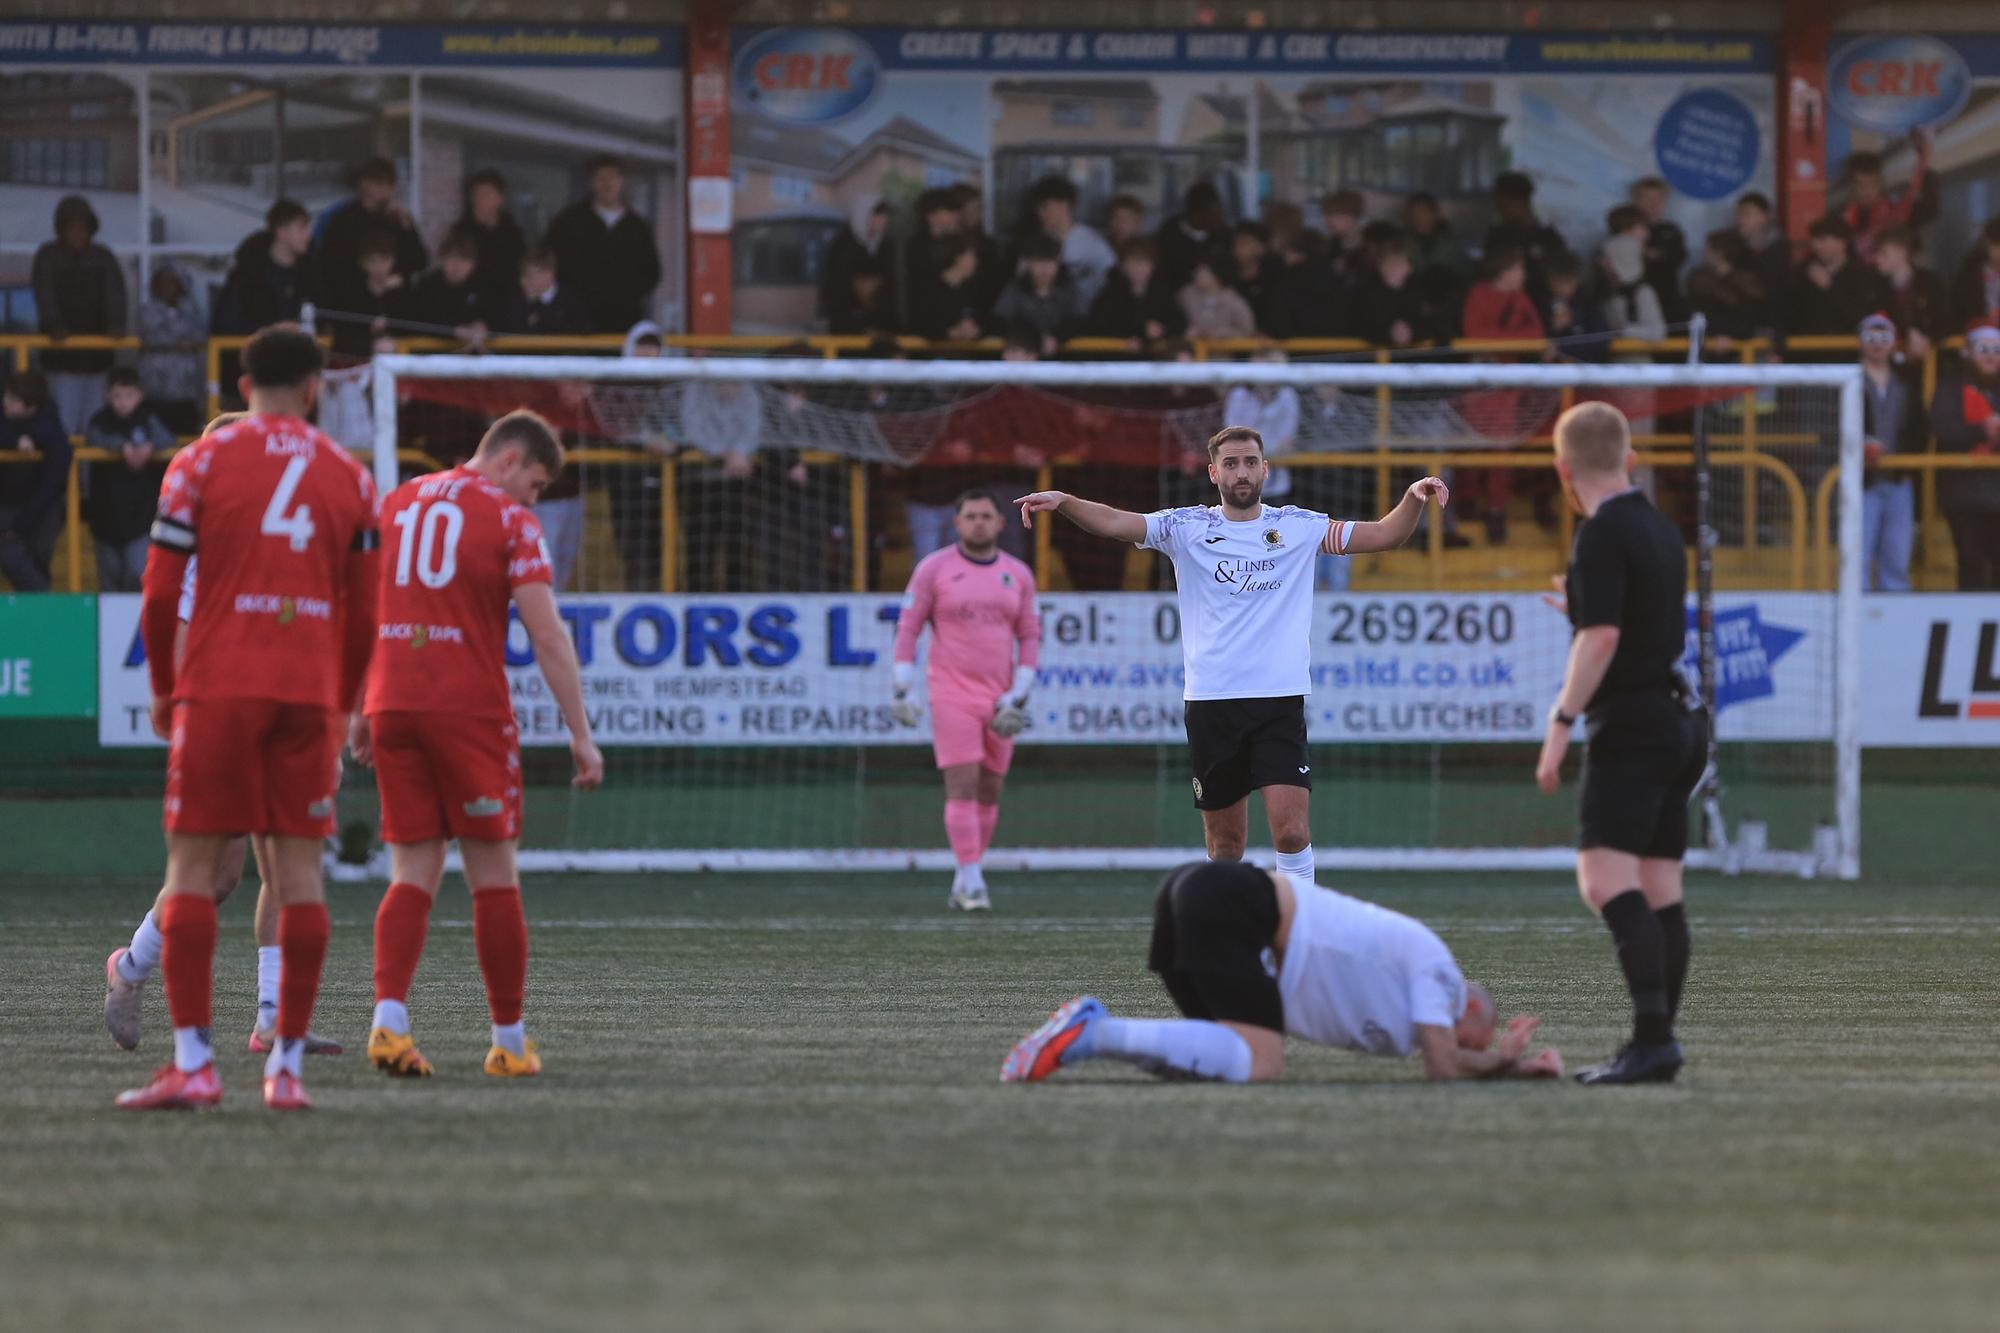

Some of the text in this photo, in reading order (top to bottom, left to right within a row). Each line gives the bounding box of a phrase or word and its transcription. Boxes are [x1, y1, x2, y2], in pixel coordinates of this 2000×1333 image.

[899, 32, 982, 60] CREATE
[991, 32, 1060, 60] SPACE
[1066, 33, 1086, 60] &
[1257, 34, 1277, 60] A
[1335, 34, 1510, 61] CONSERVATORY
[752, 53, 856, 91] CRK
[1847, 60, 1945, 97] CRK
[260, 454, 316, 553] 4
[394, 501, 465, 588] 10
[1214, 559, 1276, 584] & LINES
[1230, 574, 1283, 596] James
[505, 604, 800, 667] OTORS
[1329, 603, 1514, 645] 269260
[581, 676, 642, 698] EMEL
[654, 676, 808, 698] HEMPSTEAD
[516, 705, 704, 734] SEVICING
[741, 705, 893, 733] REPAIRS
[1343, 704, 1535, 731] CLUTCHES
